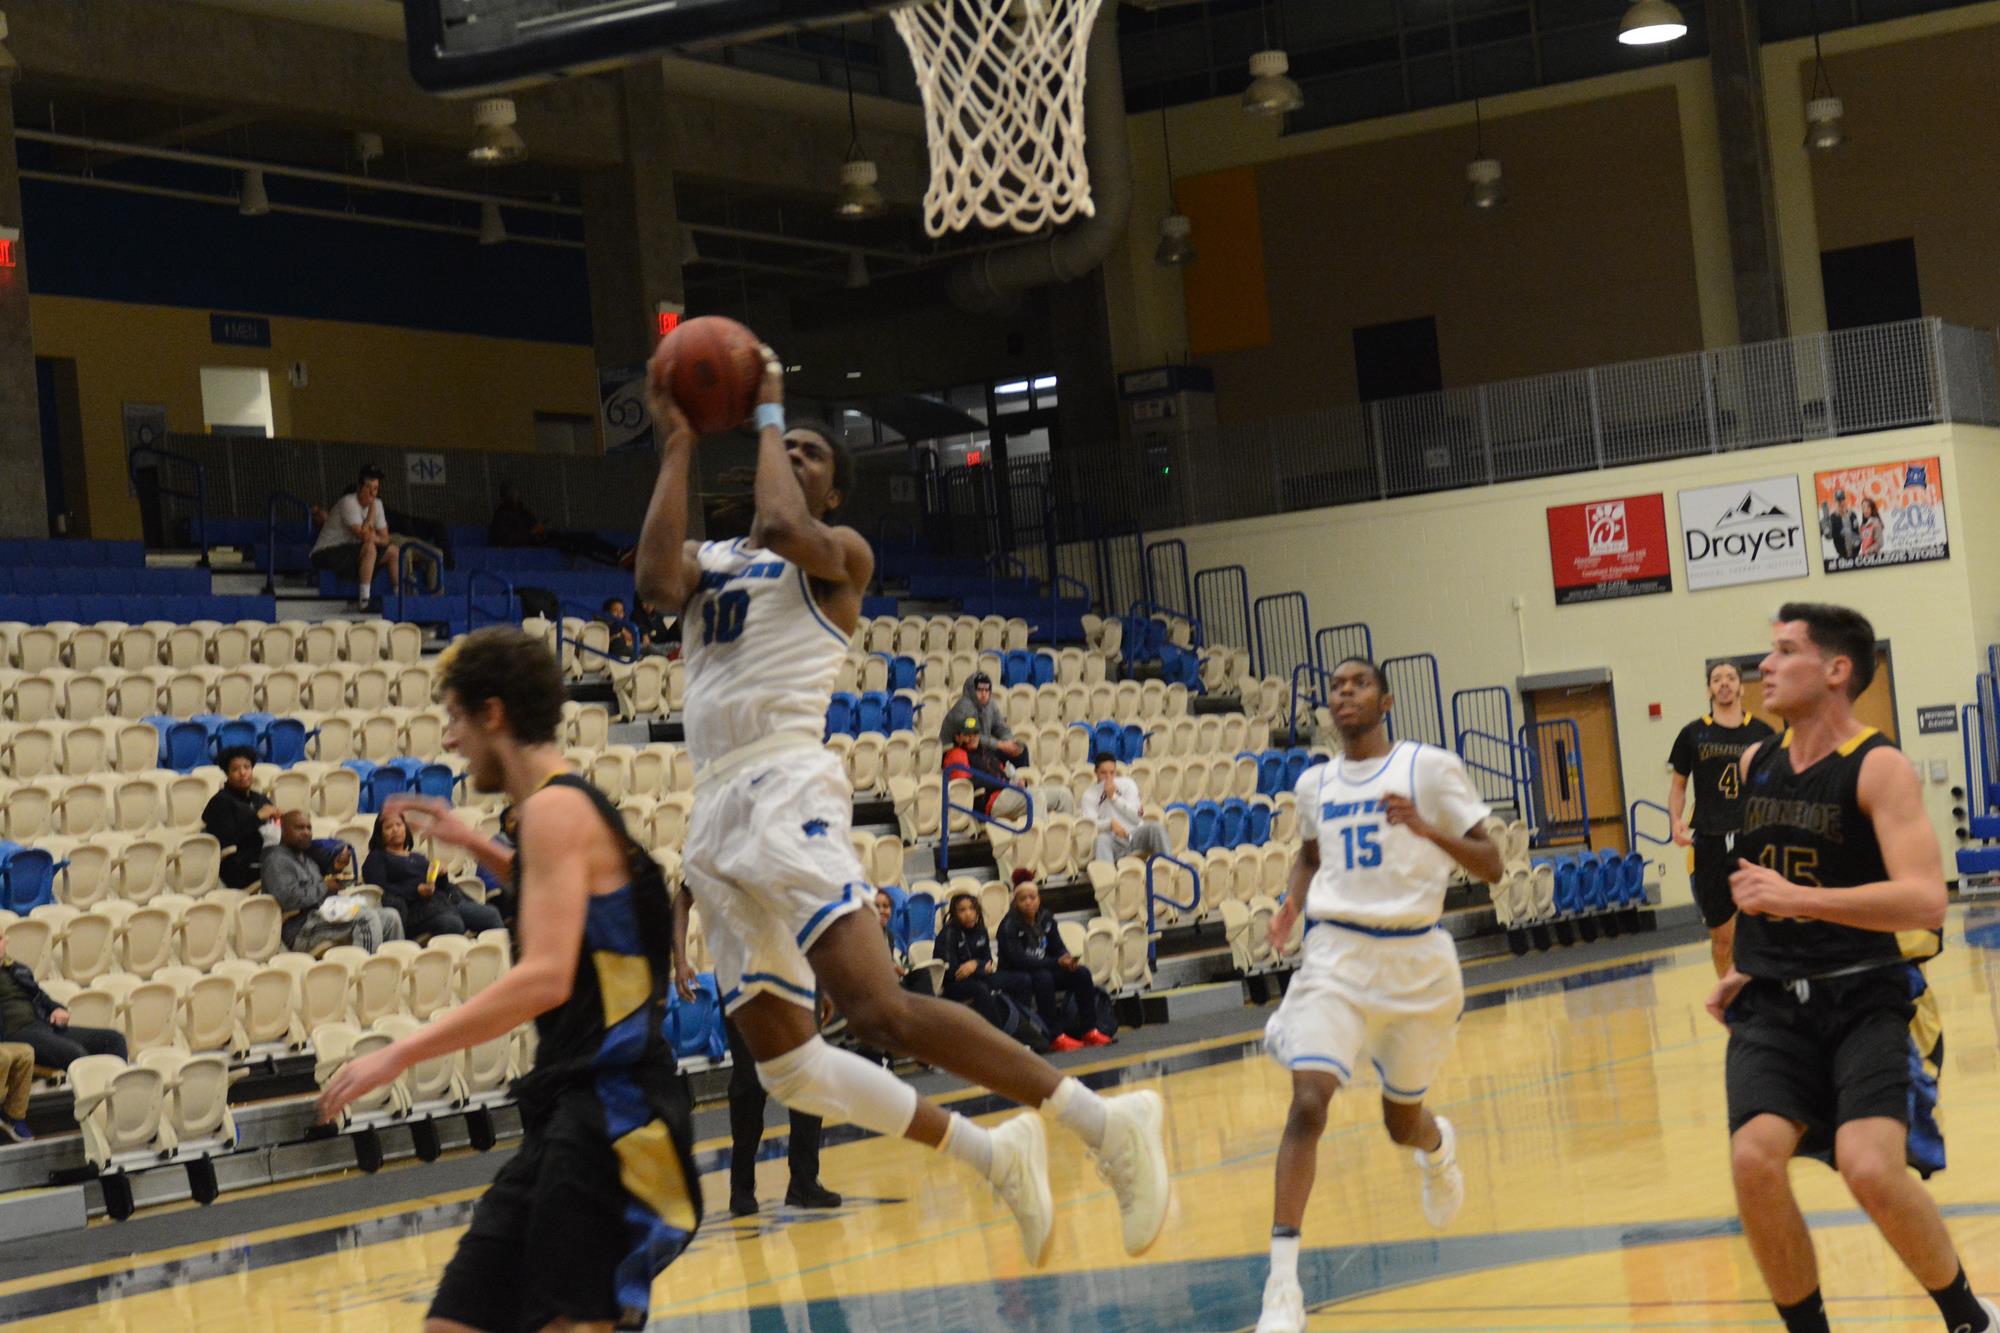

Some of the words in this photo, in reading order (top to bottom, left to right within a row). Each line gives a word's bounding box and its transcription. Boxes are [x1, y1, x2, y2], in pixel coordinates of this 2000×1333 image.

[1685, 524, 1800, 562] Drayer
[703, 589, 750, 646] 10
[1719, 763, 1739, 799] 4
[1339, 824, 1382, 870] 15
